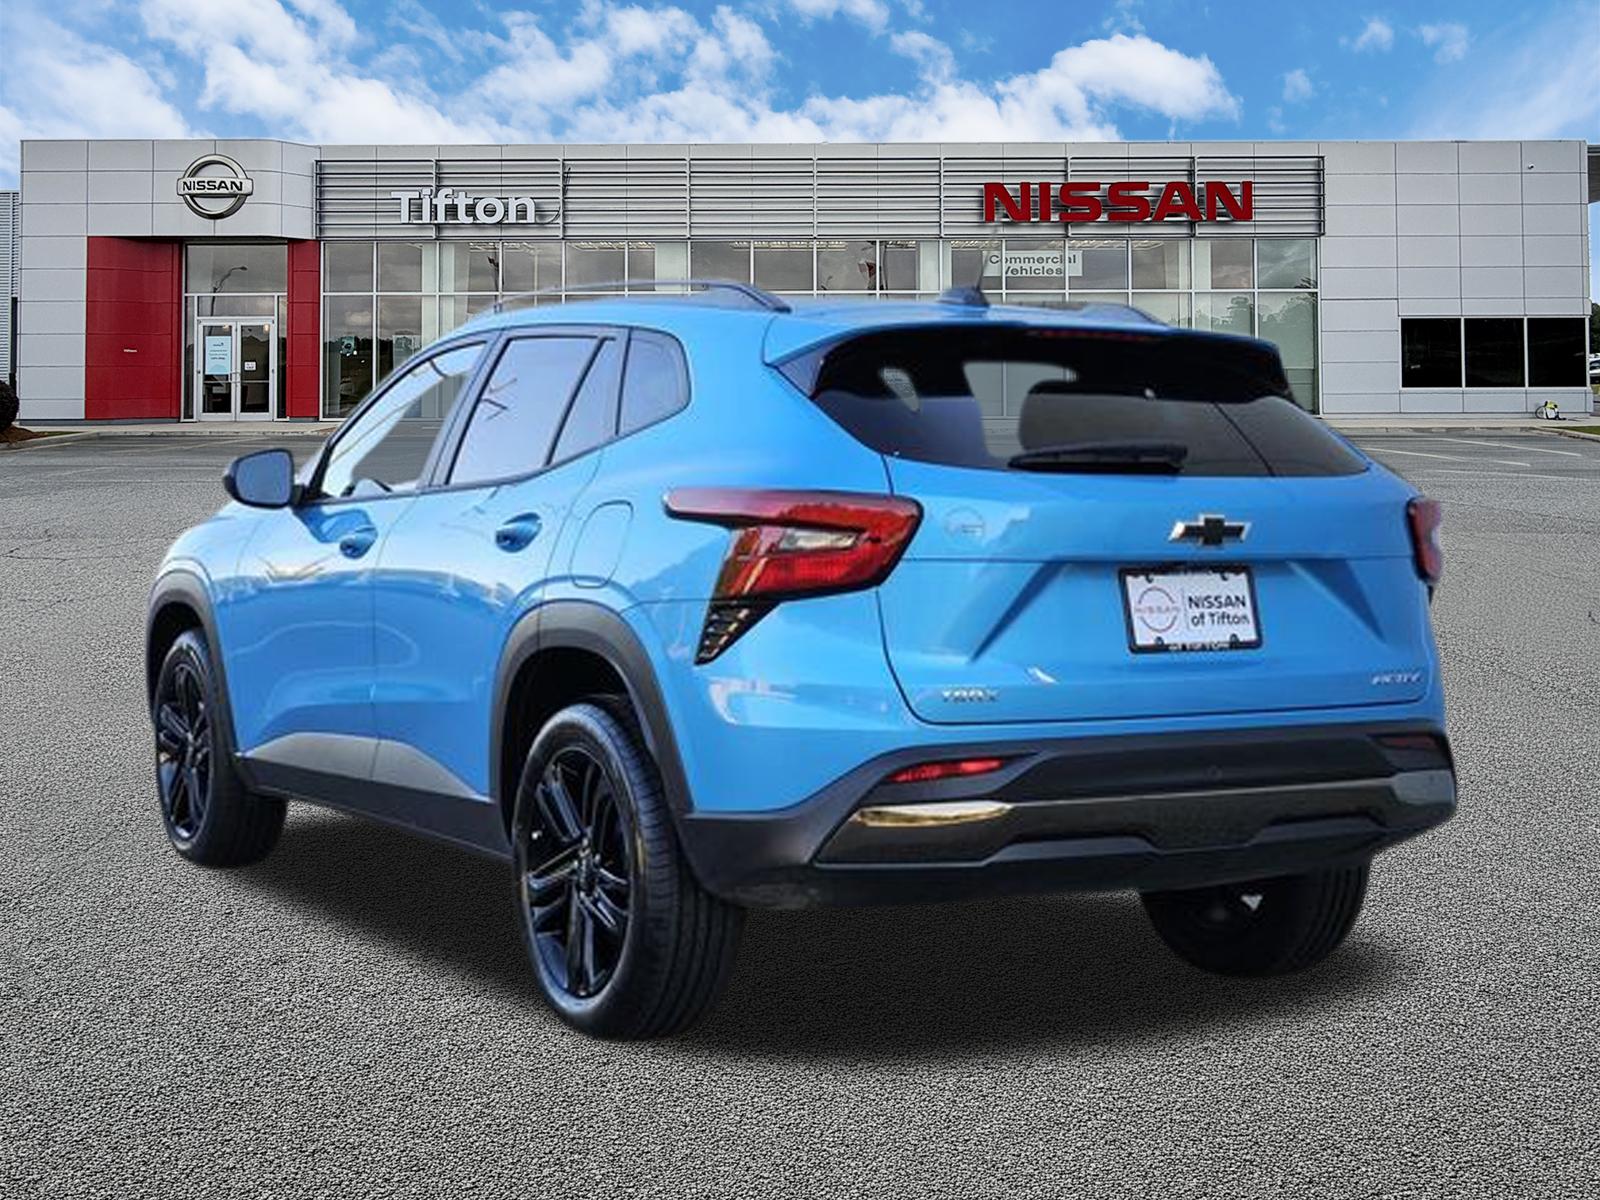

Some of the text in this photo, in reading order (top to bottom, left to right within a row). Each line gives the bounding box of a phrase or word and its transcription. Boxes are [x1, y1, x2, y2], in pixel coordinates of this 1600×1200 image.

[183, 181, 243, 191] NISSAN
[391, 188, 536, 223] Tifton
[983, 181, 1253, 222] NISSAN
[1189, 595, 1246, 609] NISSAN
[1191, 611, 1250, 627] of Tifton
